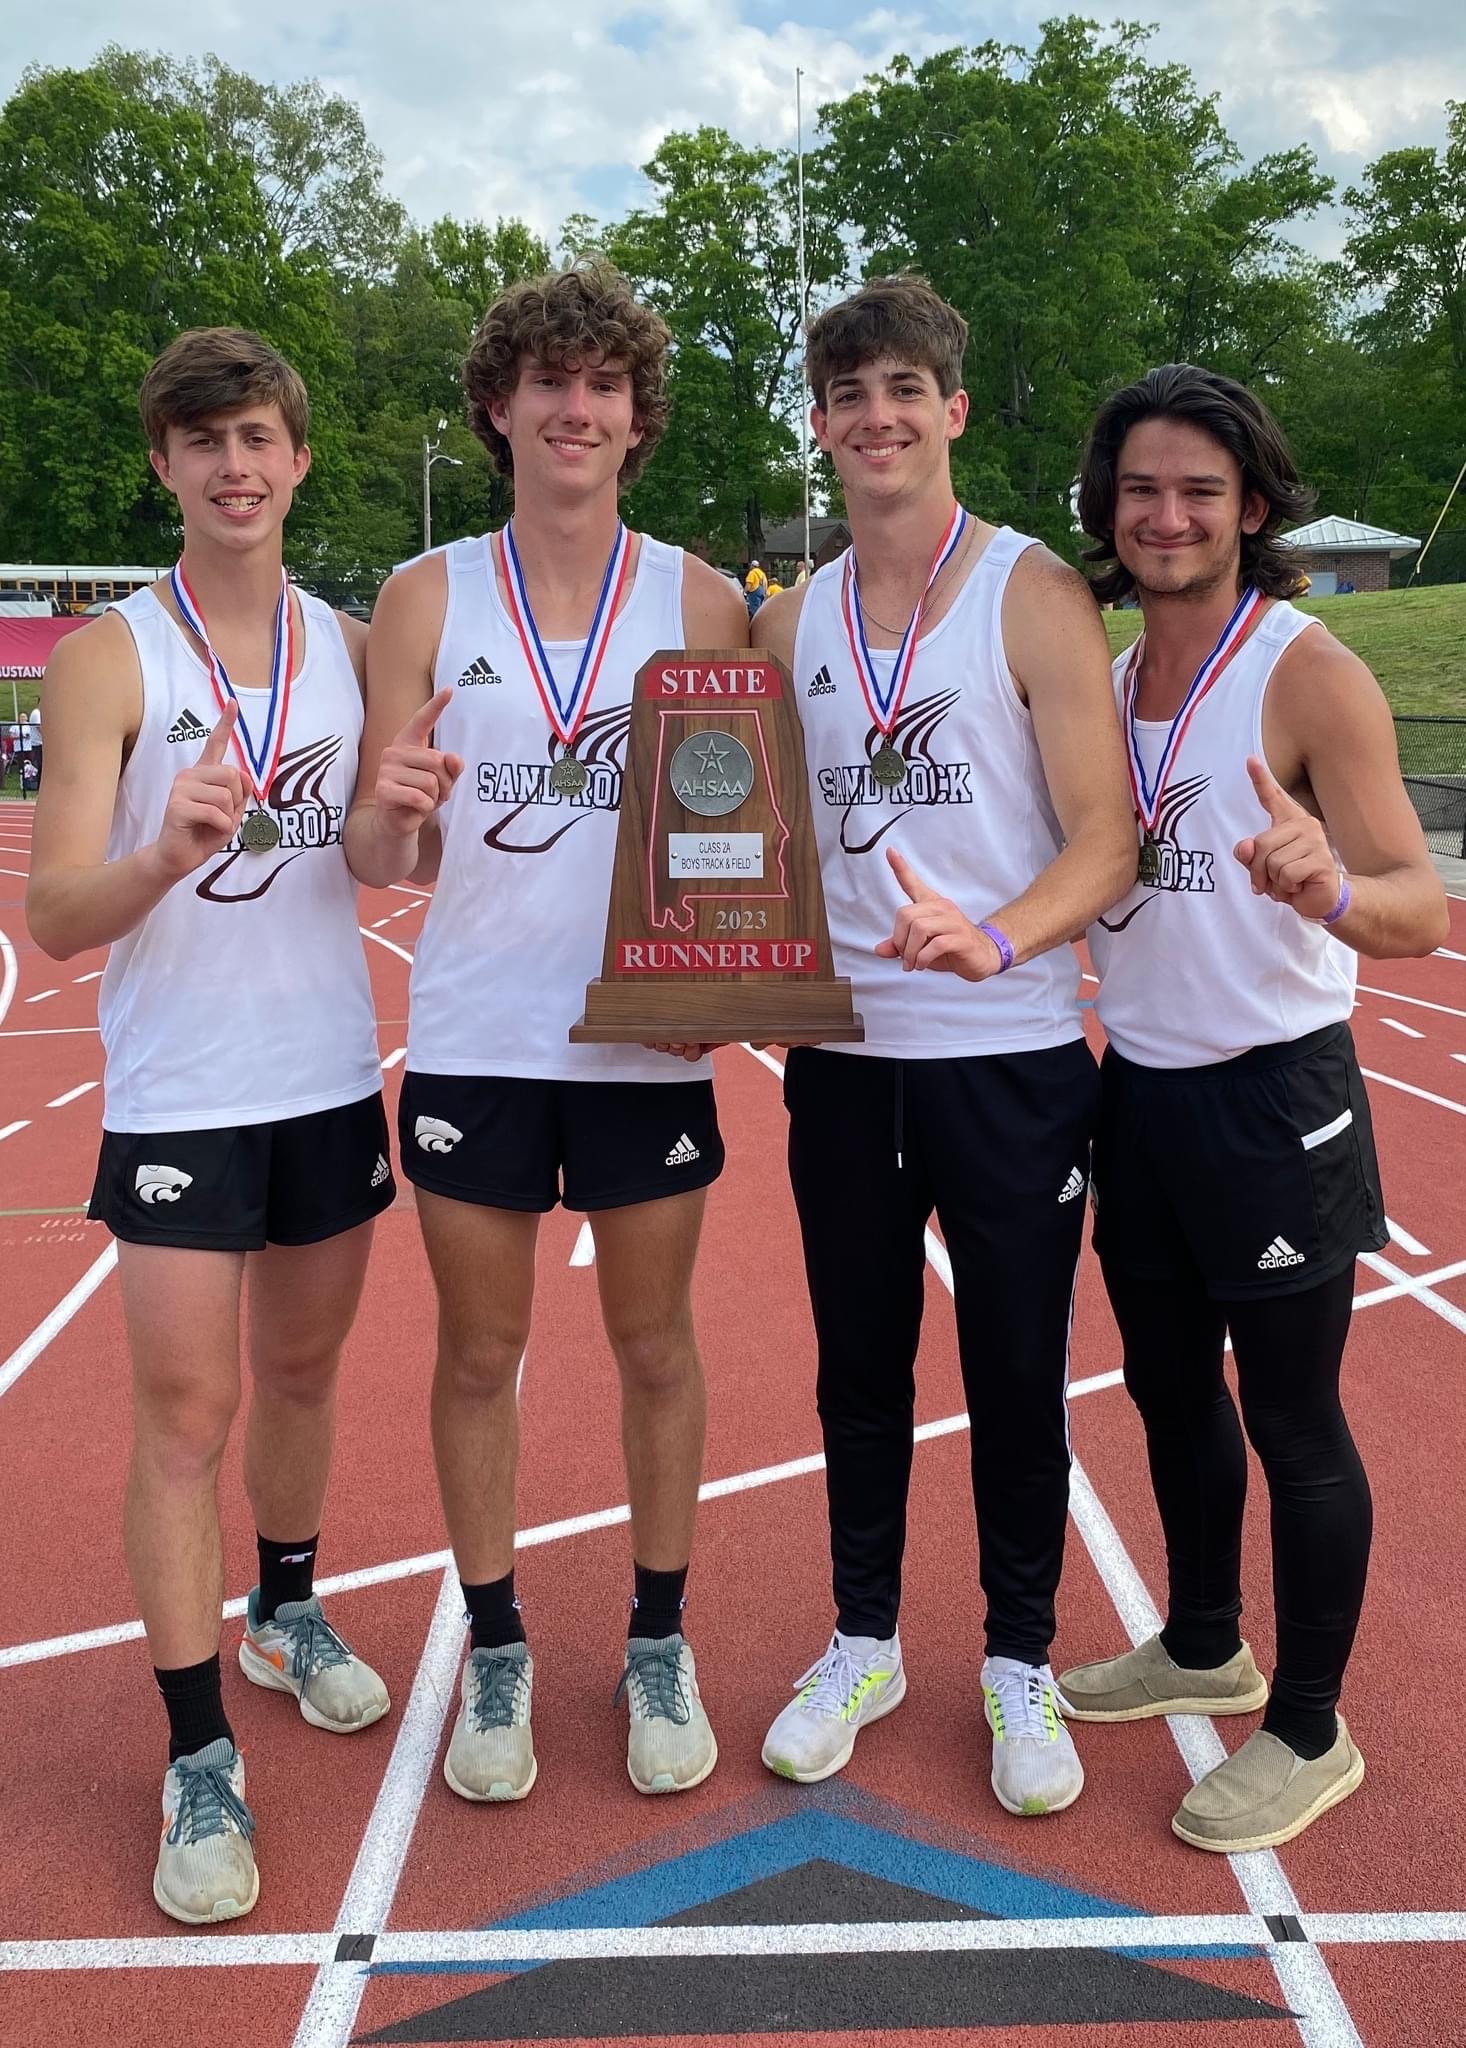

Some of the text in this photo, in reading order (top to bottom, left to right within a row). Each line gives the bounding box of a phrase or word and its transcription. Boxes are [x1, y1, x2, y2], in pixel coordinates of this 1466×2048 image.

[0, 665, 47, 678] USTAN
[457, 674, 502, 687] adidas
[661, 668, 766, 695] STATE
[807, 684, 837, 698] adidas
[554, 779, 584, 788] AHSAA
[678, 779, 746, 797] AHSAA
[278, 806, 345, 849] ROC
[699, 841, 732, 854] CLASS 2A
[681, 857, 700, 870] BOYS
[702, 857, 724, 870] TRACK
[732, 857, 751, 870] FIELD
[1143, 848, 1214, 892] OCK
[716, 910, 767, 930] 2023
[622, 943, 812, 969] RUNNER UP
[665, 1149, 700, 1166] adidas
[1257, 1252, 1306, 1270] adidas
